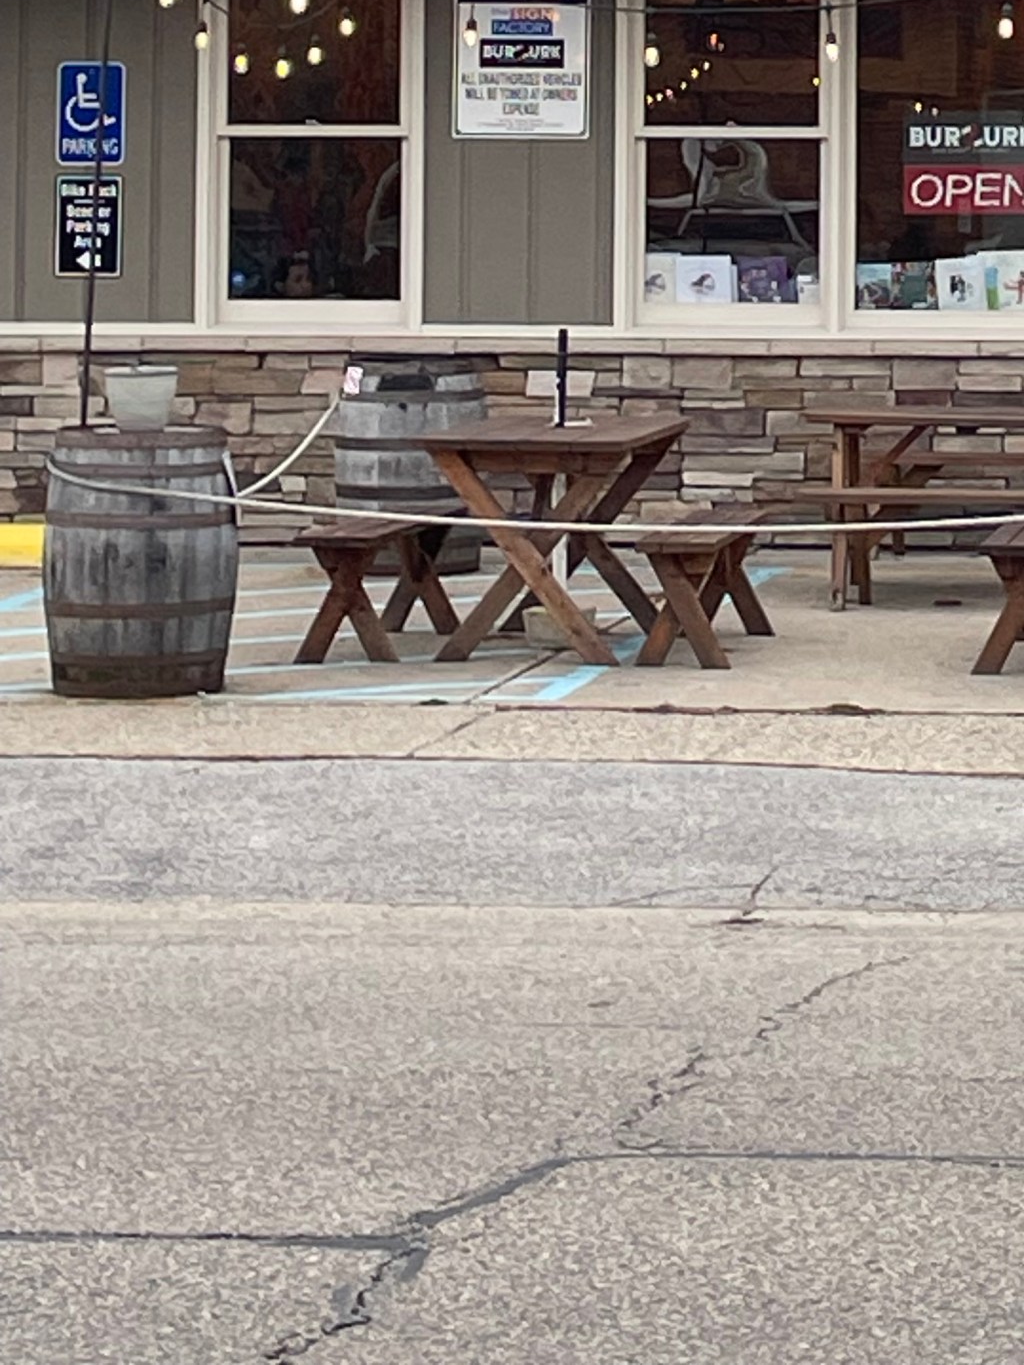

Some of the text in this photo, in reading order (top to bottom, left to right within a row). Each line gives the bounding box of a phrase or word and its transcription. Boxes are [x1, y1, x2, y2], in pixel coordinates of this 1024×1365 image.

[493, 21, 550, 33] FACTORY
[62, 138, 119, 155] PARKNG
[66, 219, 110, 236] Parkng
